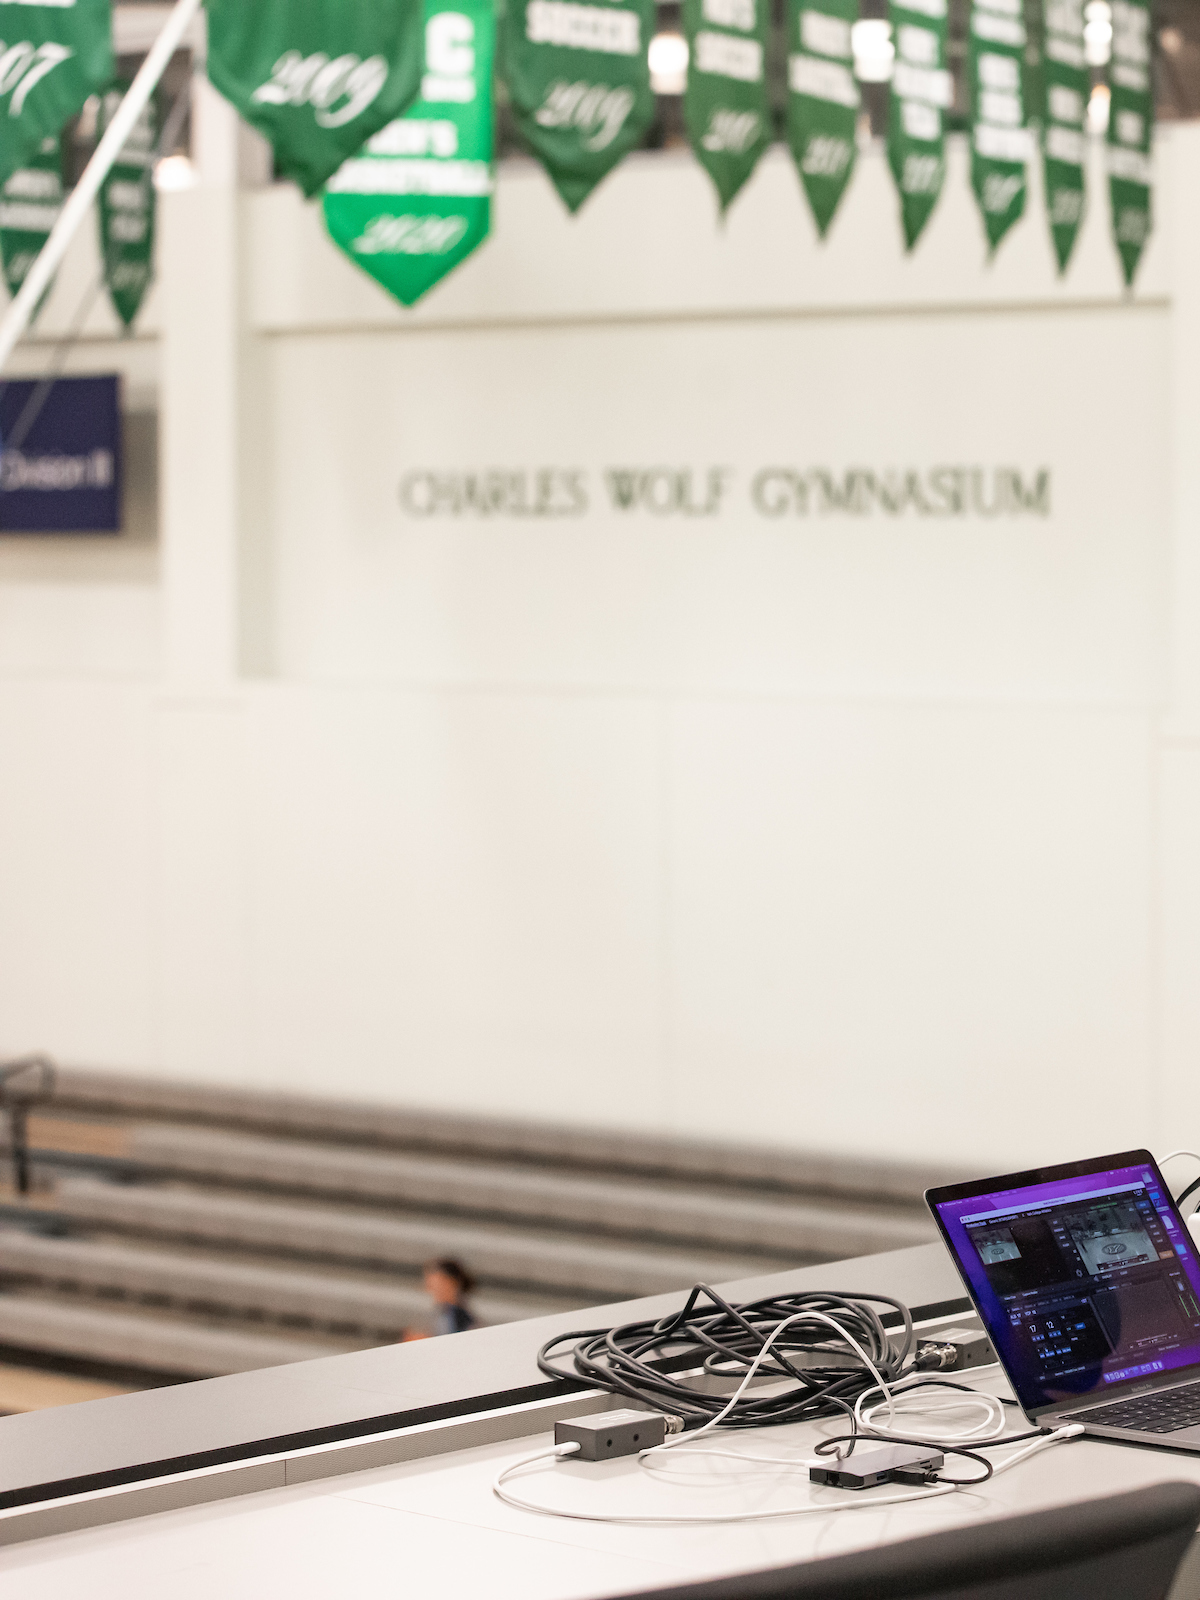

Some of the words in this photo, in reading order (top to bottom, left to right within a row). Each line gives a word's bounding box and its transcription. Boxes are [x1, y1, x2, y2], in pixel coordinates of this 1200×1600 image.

[0, 41, 75, 118] 07
[250, 49, 389, 129] 2009
[535, 79, 635, 152] 2009
[352, 212, 470, 256] 2020
[400, 466, 588, 518] CHARLES
[605, 466, 734, 516] WOLF
[752, 465, 1052, 519] GYMNASIUM
[1029, 1324, 1037, 1333] 17
[1046, 1320, 1055, 1330] 12
